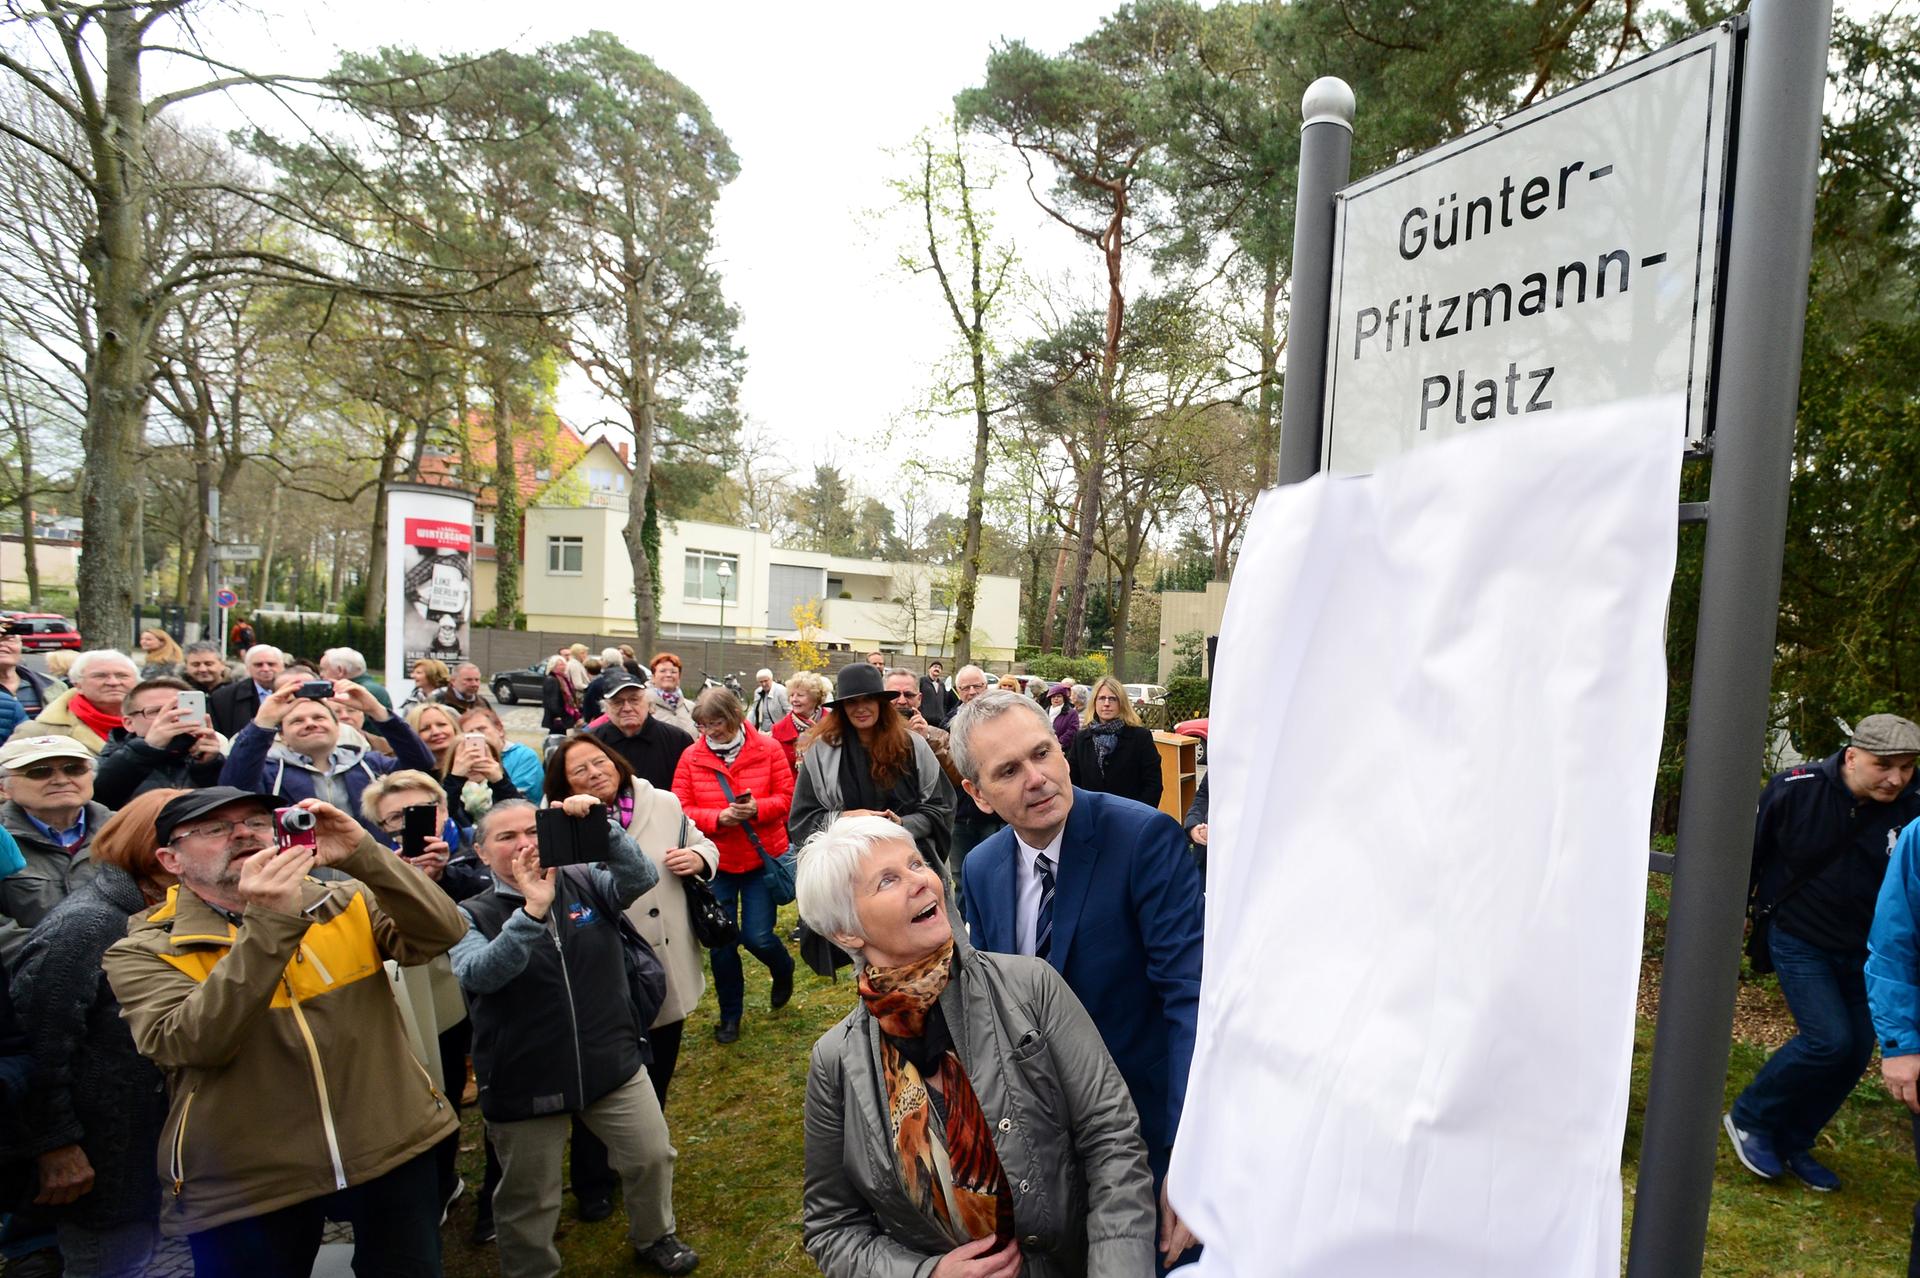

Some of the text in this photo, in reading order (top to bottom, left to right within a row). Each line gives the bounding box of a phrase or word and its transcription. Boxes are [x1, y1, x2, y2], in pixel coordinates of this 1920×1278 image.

[1398, 160, 1614, 261] Günter-
[1353, 248, 1668, 361] Pfitzmann-
[1419, 362, 1555, 431] Platz
